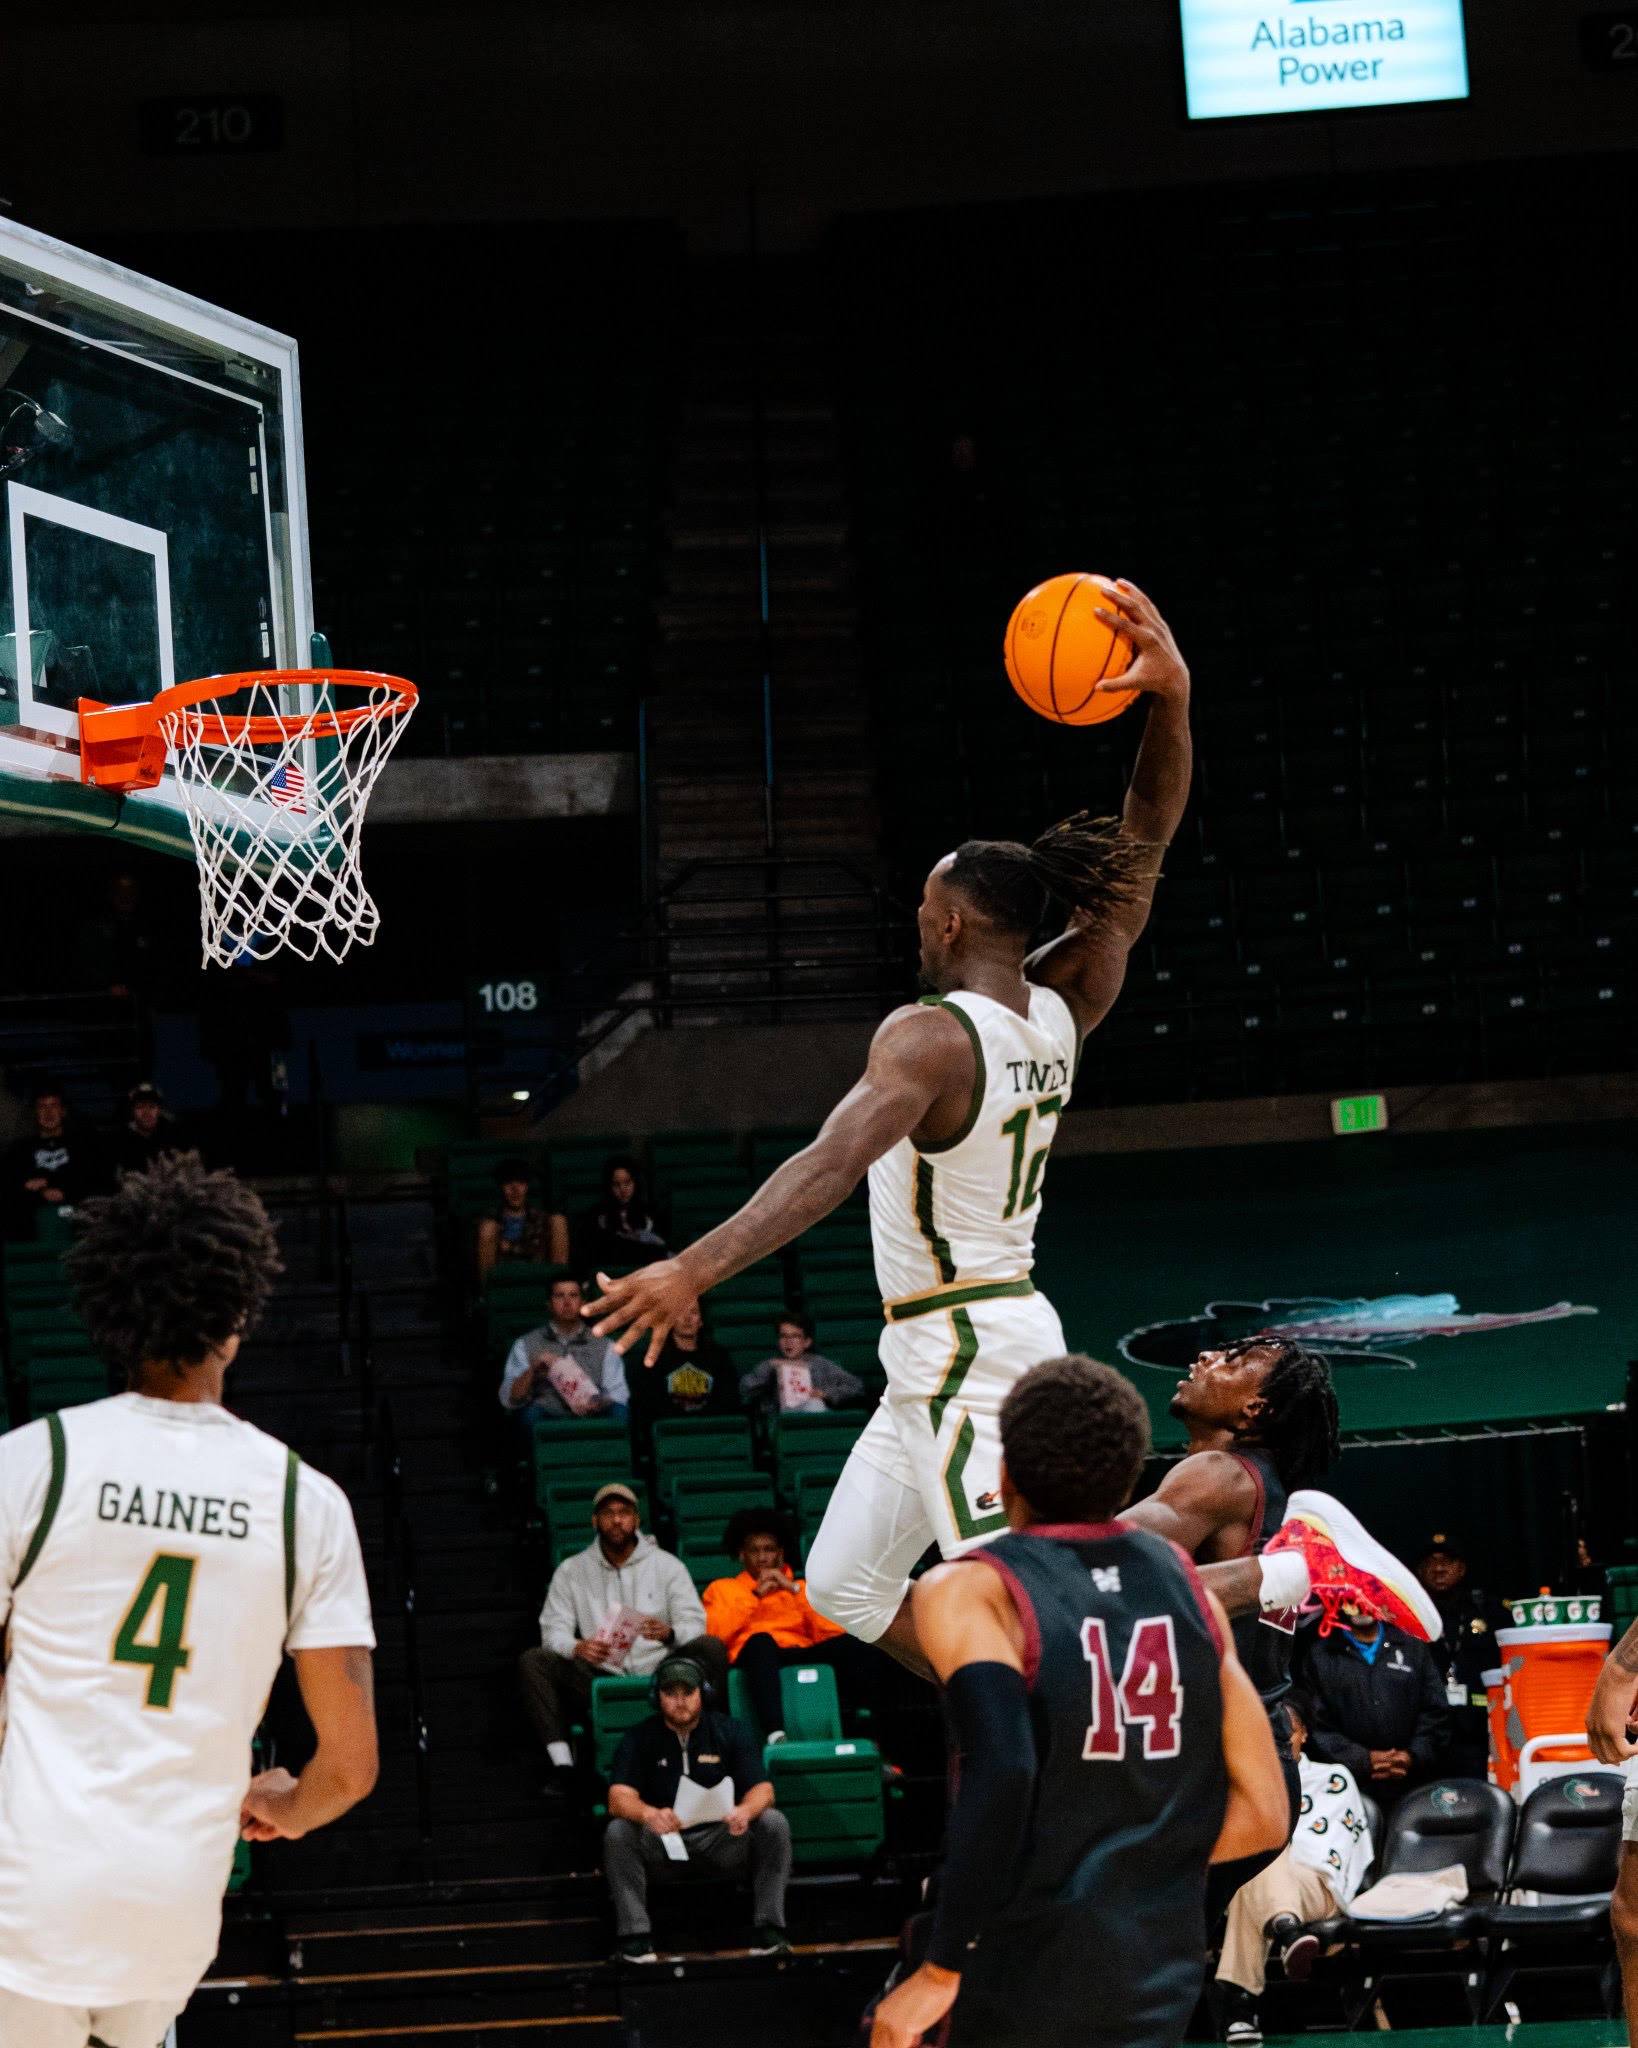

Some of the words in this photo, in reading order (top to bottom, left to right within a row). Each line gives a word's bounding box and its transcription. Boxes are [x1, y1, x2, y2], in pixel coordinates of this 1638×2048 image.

[1251, 17, 1404, 50] Alabama
[1279, 56, 1383, 87] Power
[175, 105, 250, 144] 210
[479, 981, 538, 1012] 108
[1341, 1096, 1378, 1131] EXIT
[1001, 1094, 1063, 1220] 12
[98, 1482, 250, 1539] GAINES
[110, 1550, 199, 1712] 4
[1080, 1615, 1184, 1761] 14
